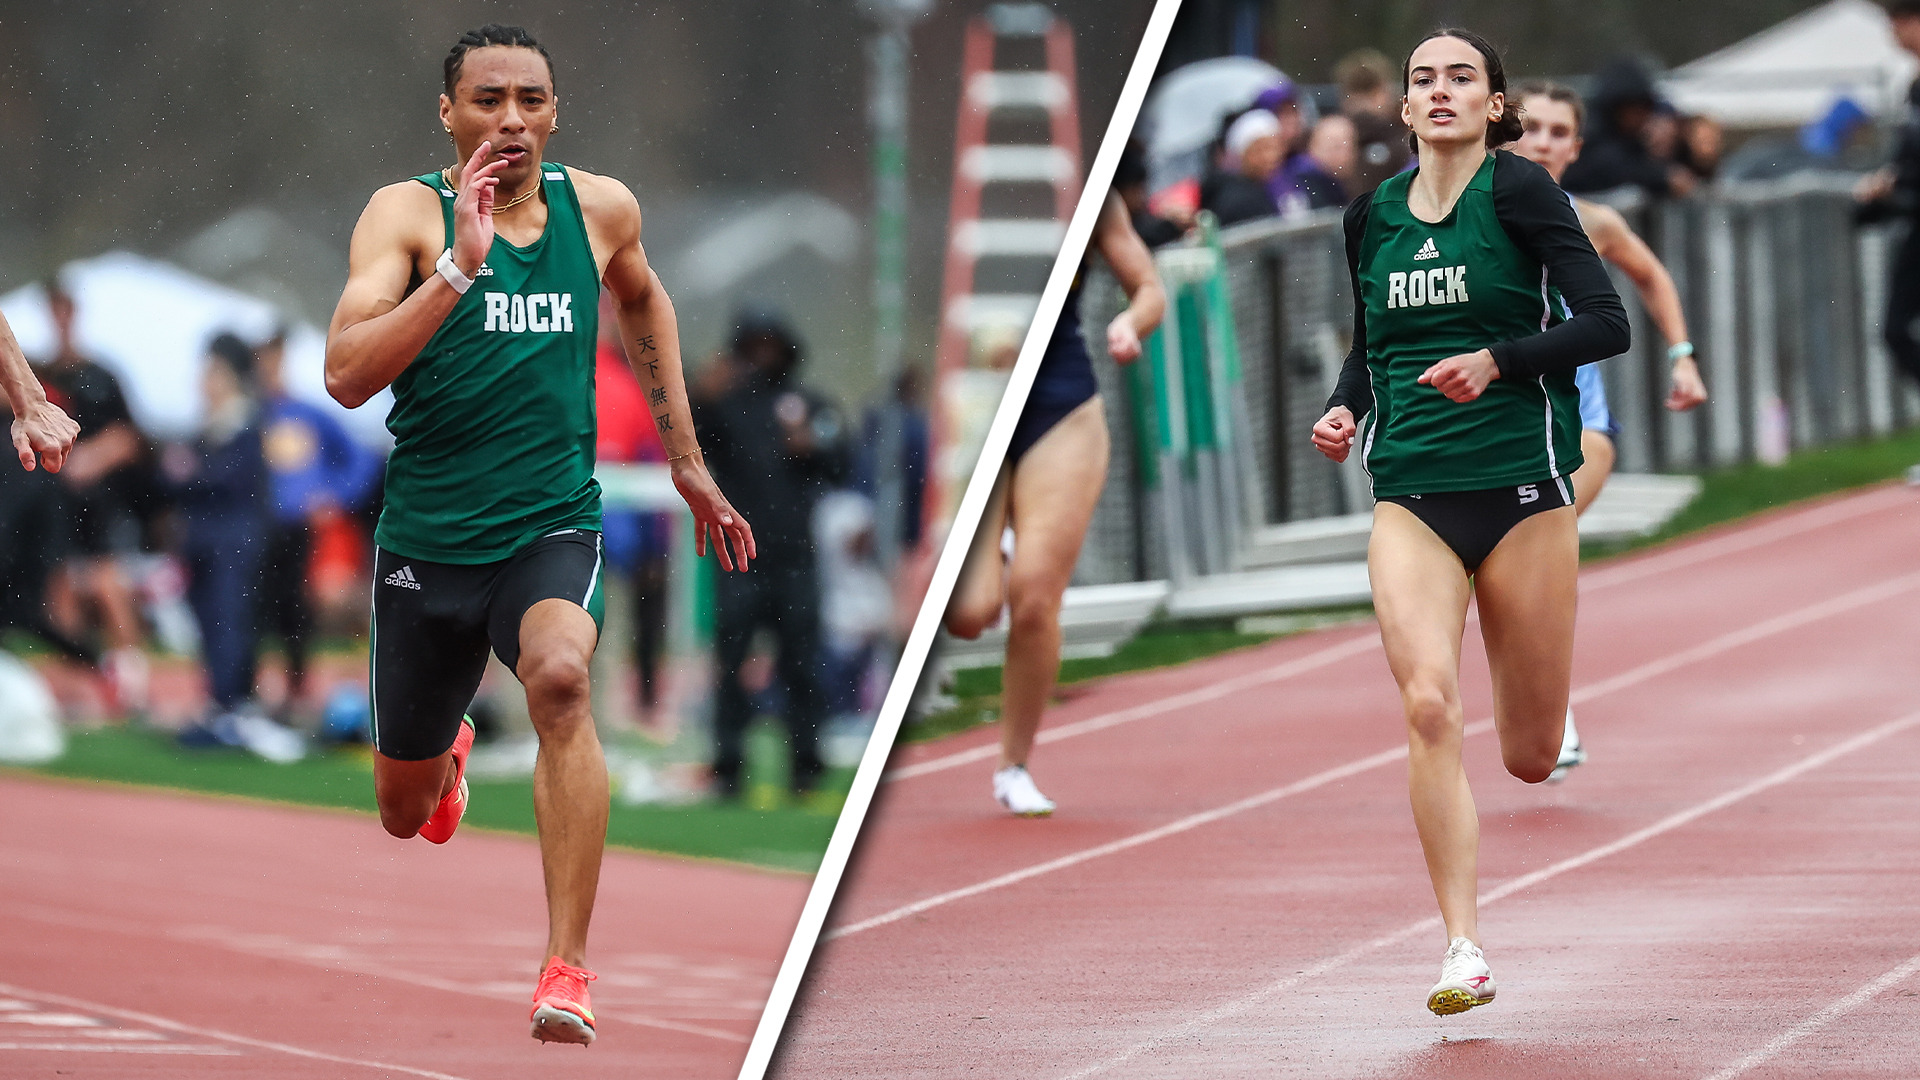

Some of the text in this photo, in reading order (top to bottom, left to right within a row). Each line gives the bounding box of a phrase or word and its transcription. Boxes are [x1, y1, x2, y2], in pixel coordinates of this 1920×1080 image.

[1413, 250, 1440, 261] adidas
[1387, 265, 1469, 309] ROCK
[484, 292, 574, 333] ROCK
[636, 335, 674, 433] 天下無双
[1517, 484, 1540, 505] S
[384, 577, 421, 591] adidas
